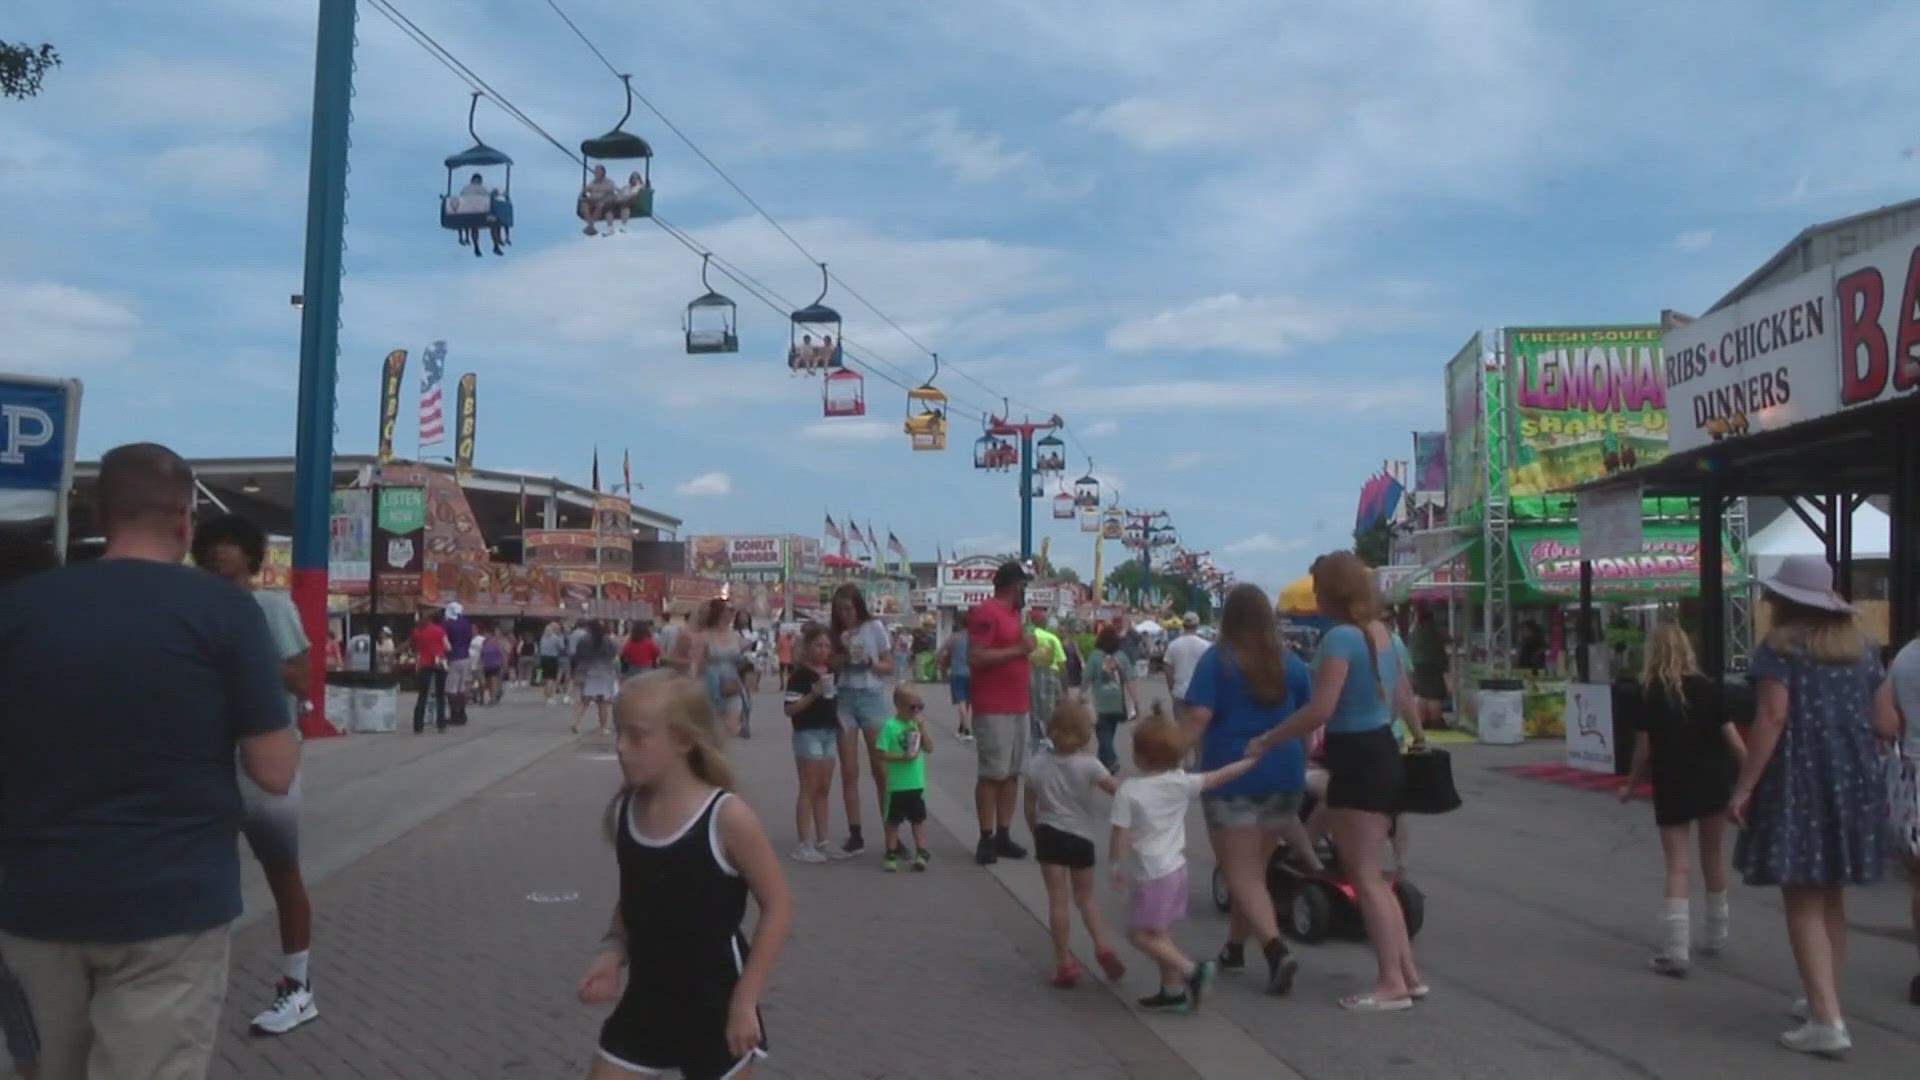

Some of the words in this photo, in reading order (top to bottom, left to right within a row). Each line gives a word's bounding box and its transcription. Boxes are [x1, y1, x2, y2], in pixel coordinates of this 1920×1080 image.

[1518, 332, 1587, 343] FRESH
[1666, 342, 1707, 389] RIBS
[1719, 296, 1824, 369] CHICKEN
[1693, 366, 1791, 429] DINNERS
[733, 540, 775, 552] DONUT
[731, 552, 778, 563] BURGER
[951, 568, 999, 580] PIZZ
